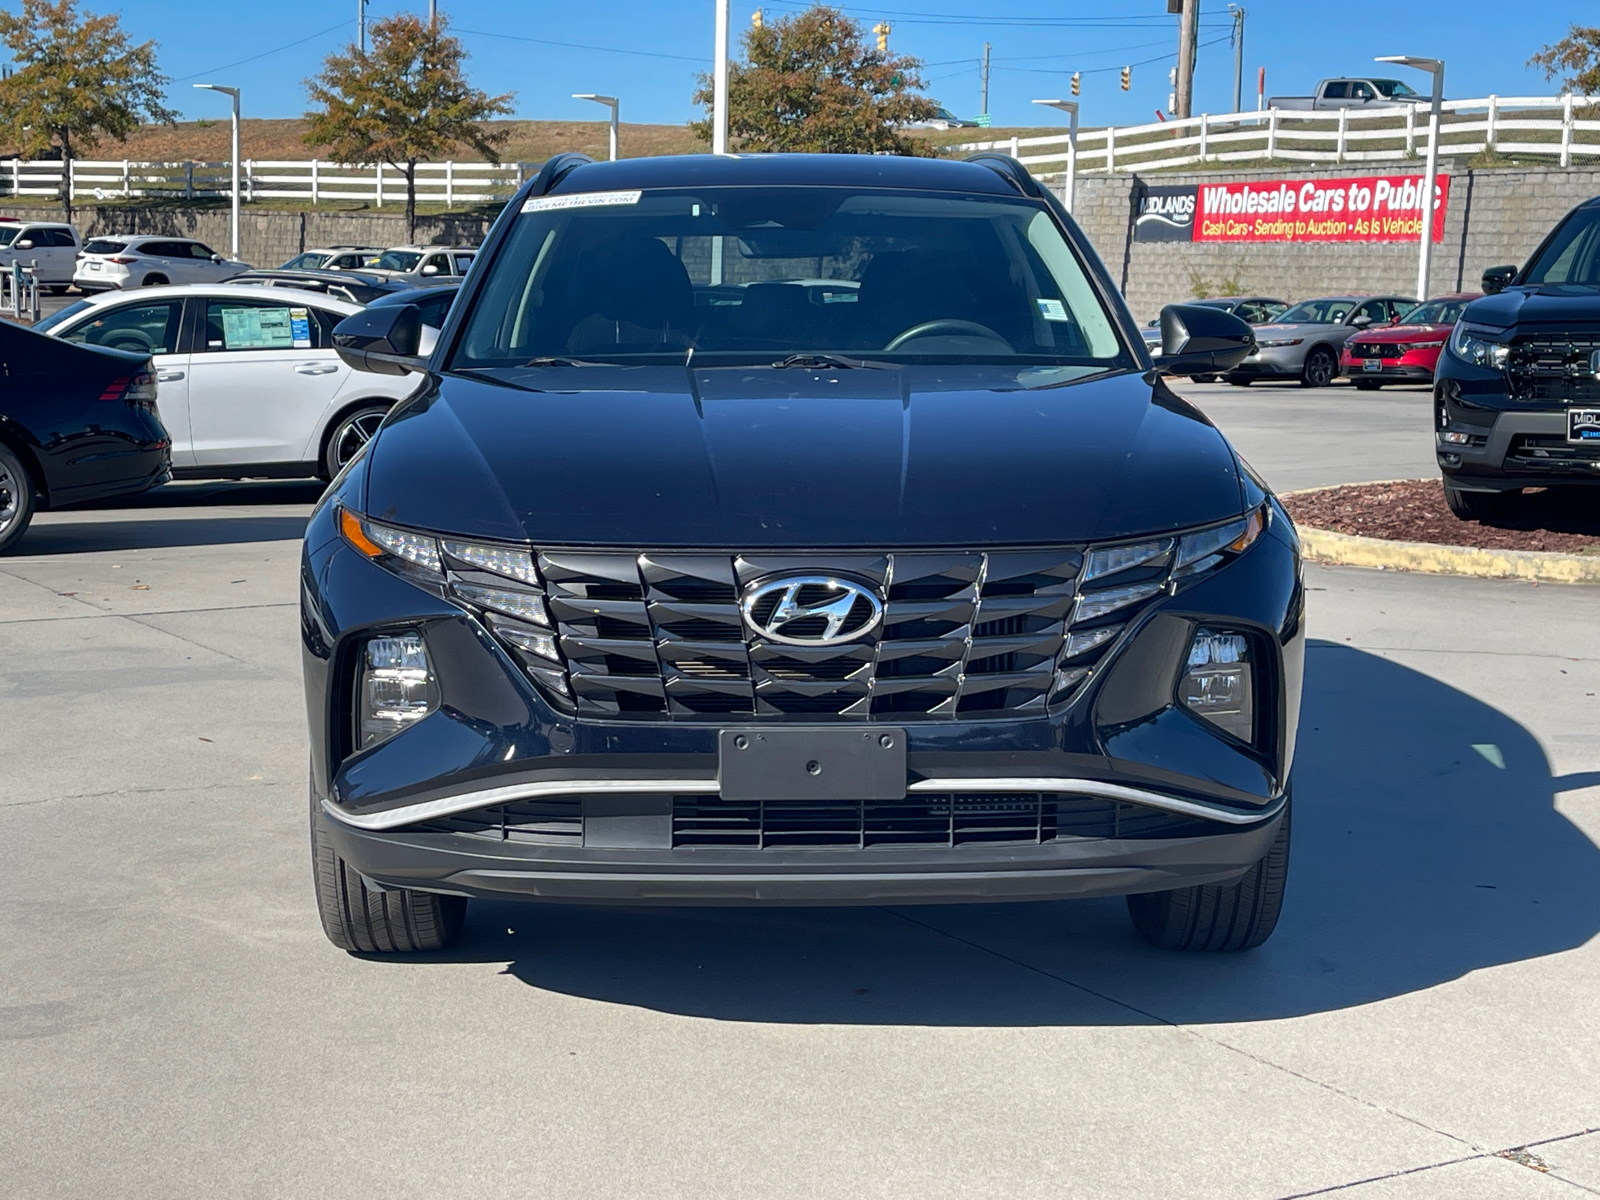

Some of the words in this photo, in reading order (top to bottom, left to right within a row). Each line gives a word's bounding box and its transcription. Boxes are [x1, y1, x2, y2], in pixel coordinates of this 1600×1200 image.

[1204, 184, 1296, 214] Wholesale
[1300, 182, 1345, 212] Cars
[1348, 183, 1371, 211] to
[1202, 220, 1226, 236] Cash
[1226, 220, 1248, 236] Cars
[1254, 219, 1294, 239] Sending
[1295, 220, 1306, 235] to
[1307, 218, 1347, 235] Auction
[1354, 218, 1369, 235] As
[1371, 217, 1381, 234] Is
[1383, 217, 1423, 235] Vehicle
